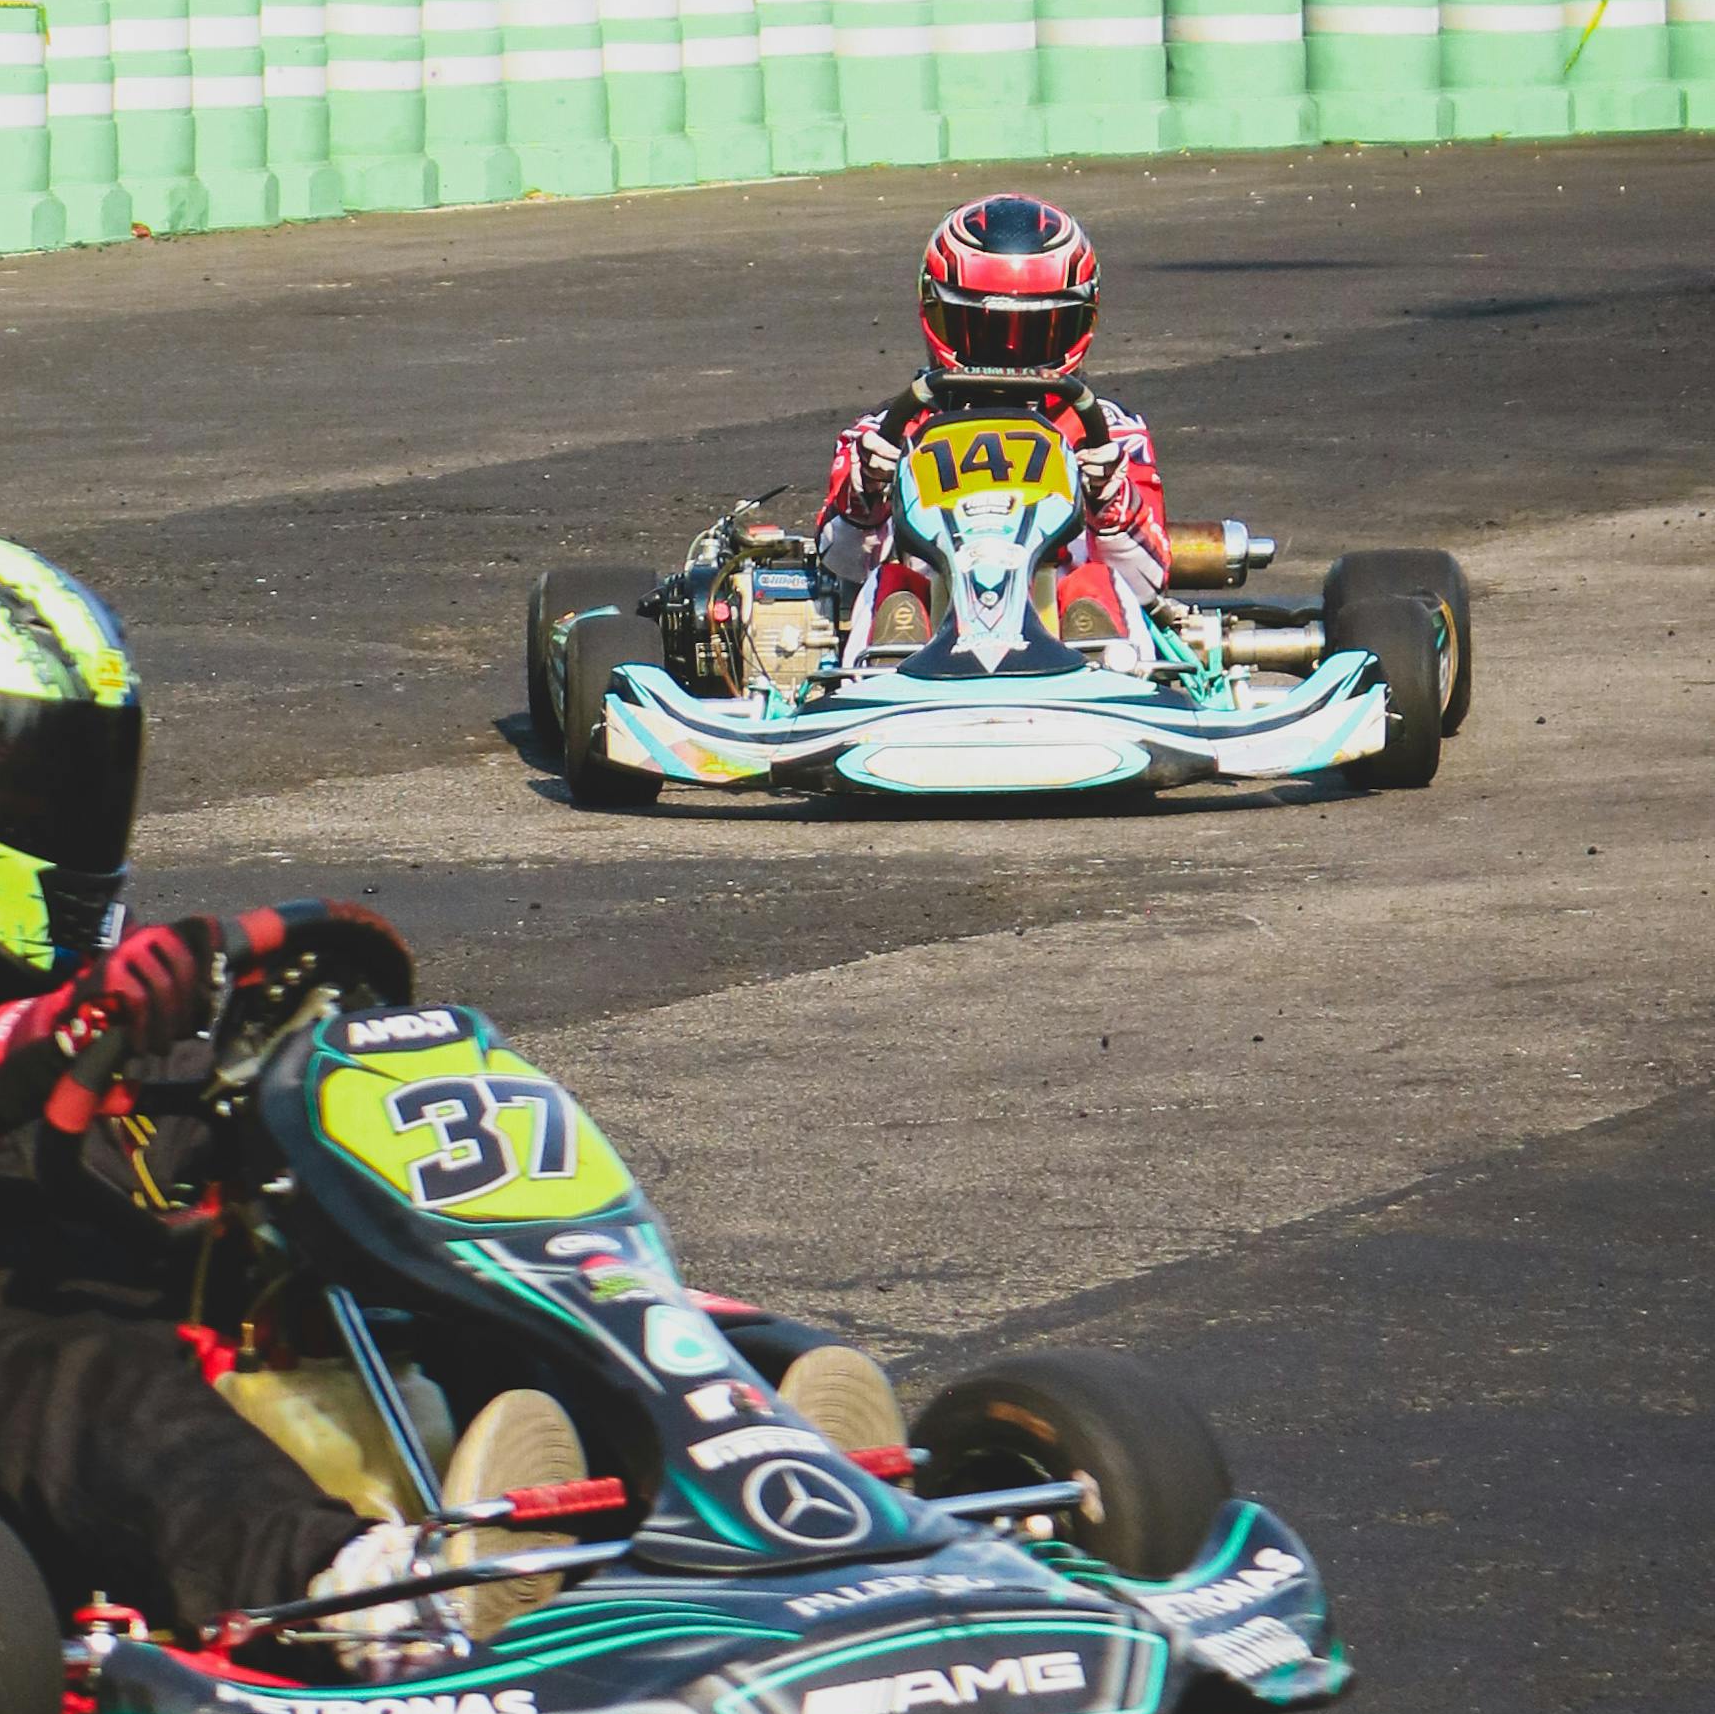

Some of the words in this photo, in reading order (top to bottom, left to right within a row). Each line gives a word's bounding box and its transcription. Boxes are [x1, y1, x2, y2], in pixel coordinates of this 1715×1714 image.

[920, 431, 1052, 492] 147
[386, 1073, 578, 1210] 37
[888, 1651, 1086, 1714] AMG
